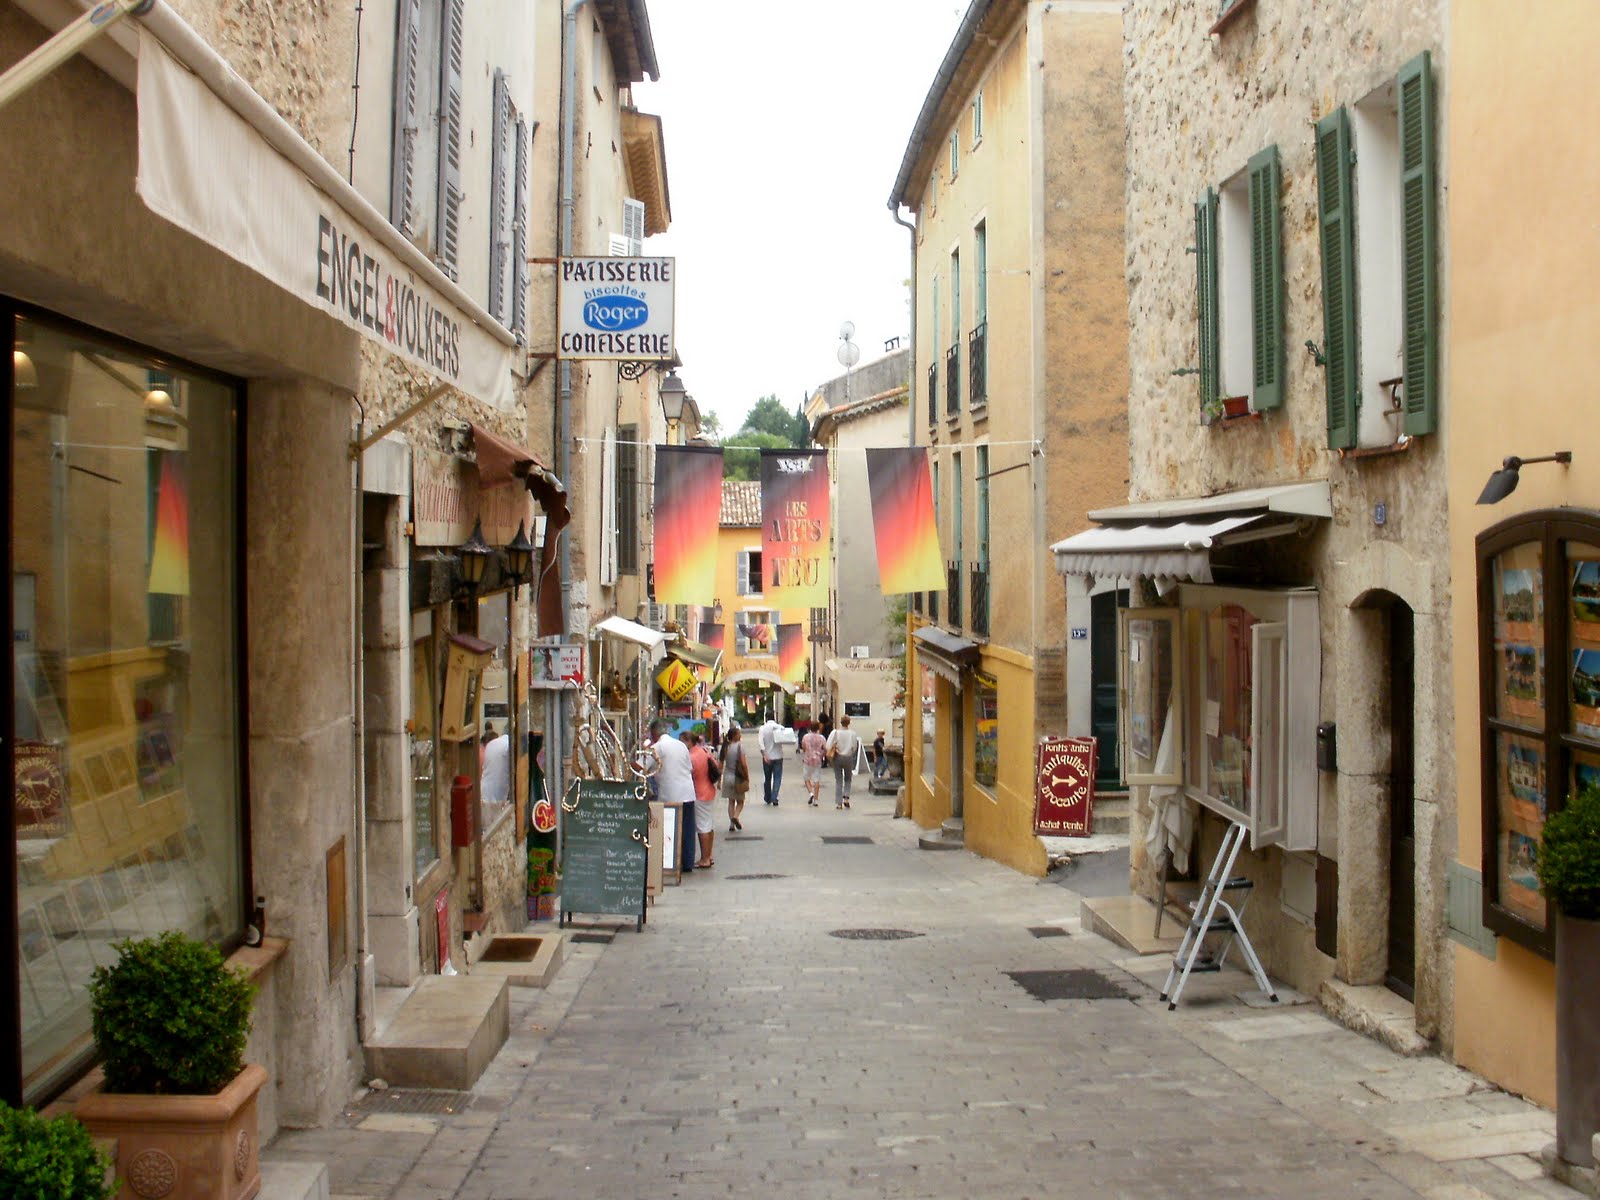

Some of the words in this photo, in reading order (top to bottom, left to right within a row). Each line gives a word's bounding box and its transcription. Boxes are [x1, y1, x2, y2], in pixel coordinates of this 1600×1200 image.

[562, 260, 671, 281] PATISSERIE
[584, 284, 647, 300] biscottes
[586, 302, 646, 328] Roger
[561, 332, 670, 353] CONFISERIE
[786, 501, 807, 517] LES
[769, 519, 822, 541] ARTS
[772, 558, 820, 586] FEU
[672, 678, 694, 698] PRESSE
